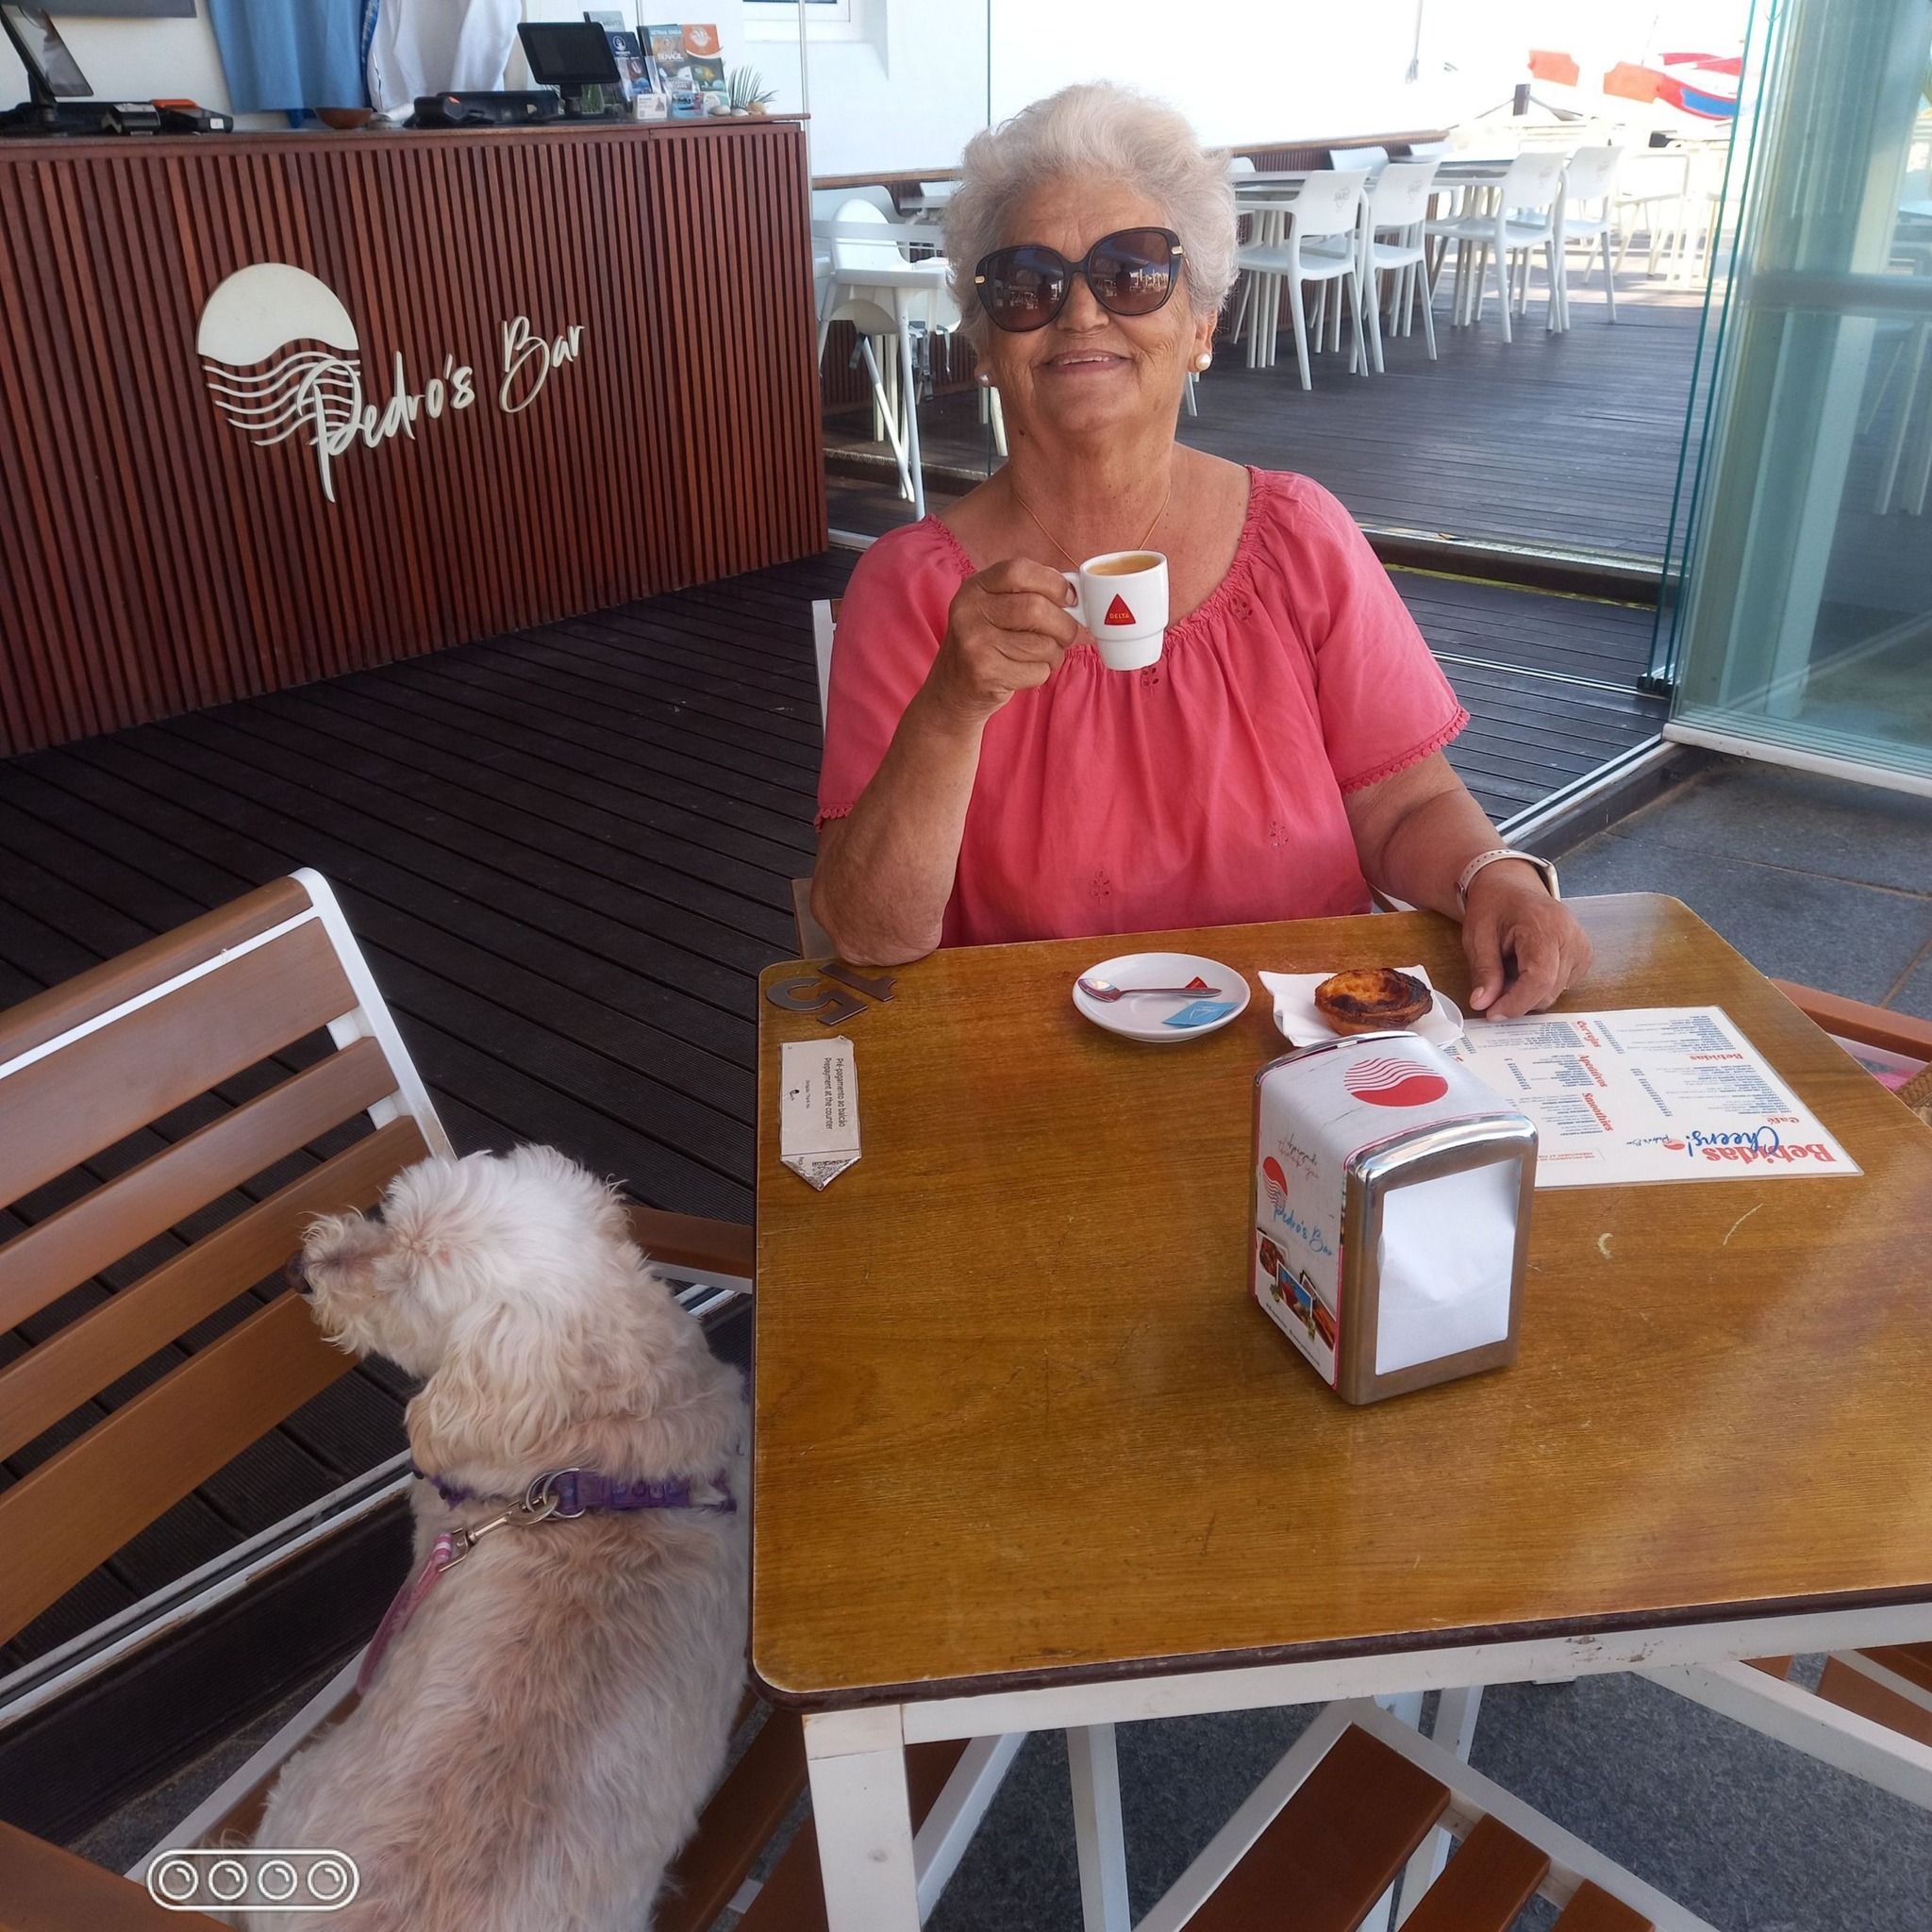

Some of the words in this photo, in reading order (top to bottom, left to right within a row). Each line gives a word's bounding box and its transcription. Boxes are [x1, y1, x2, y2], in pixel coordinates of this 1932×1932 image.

[295, 350, 475, 504] Pedro's
[499, 314, 586, 414] Bar
[822, 1057, 832, 1090] Prepayment
[834, 1058, 844, 1100] Pré-pagamento
[824, 1097, 833, 1108] the
[838, 1108, 847, 1127] balcão
[1581, 1092, 1614, 1132] Smoothies
[1767, 1116, 1800, 1124] Café
[1687, 1125, 1780, 1158] Cheers!
[1702, 1142, 1838, 1164] Bebidas
[1274, 1189, 1307, 1240] Pedro's
[1308, 1225, 1333, 1257] Bar
